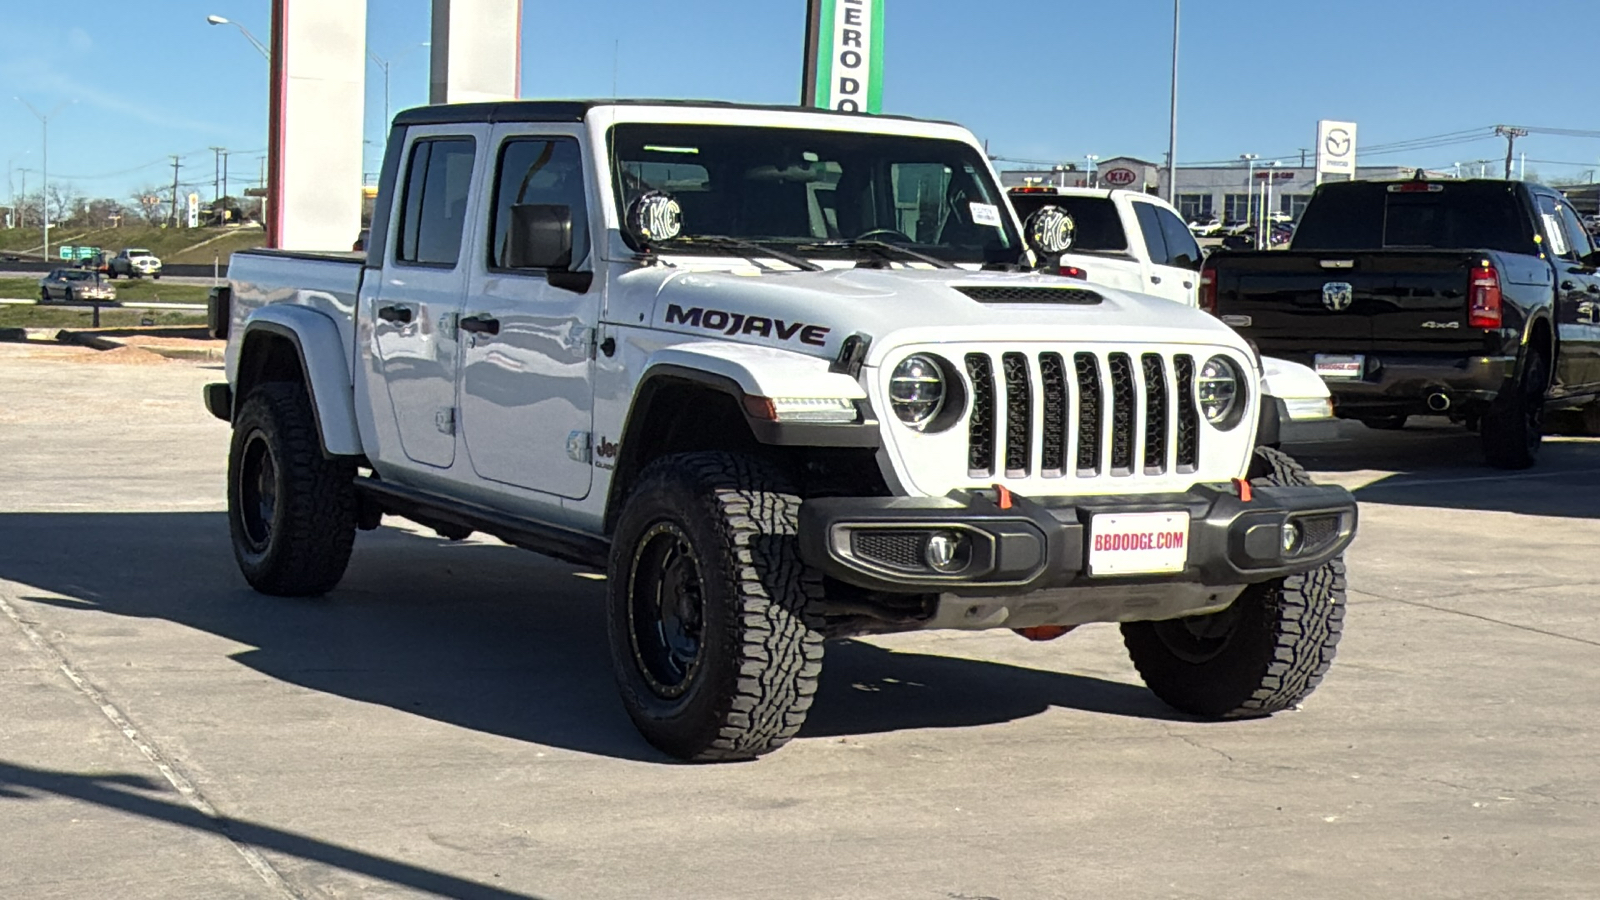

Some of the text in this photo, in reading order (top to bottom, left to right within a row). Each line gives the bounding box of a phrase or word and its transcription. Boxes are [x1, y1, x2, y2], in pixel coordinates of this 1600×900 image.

[650, 197, 680, 239] KC
[1043, 212, 1074, 252] KC
[665, 303, 831, 347] MOJAVE
[1095, 531, 1184, 552] BBDODGE.COM
